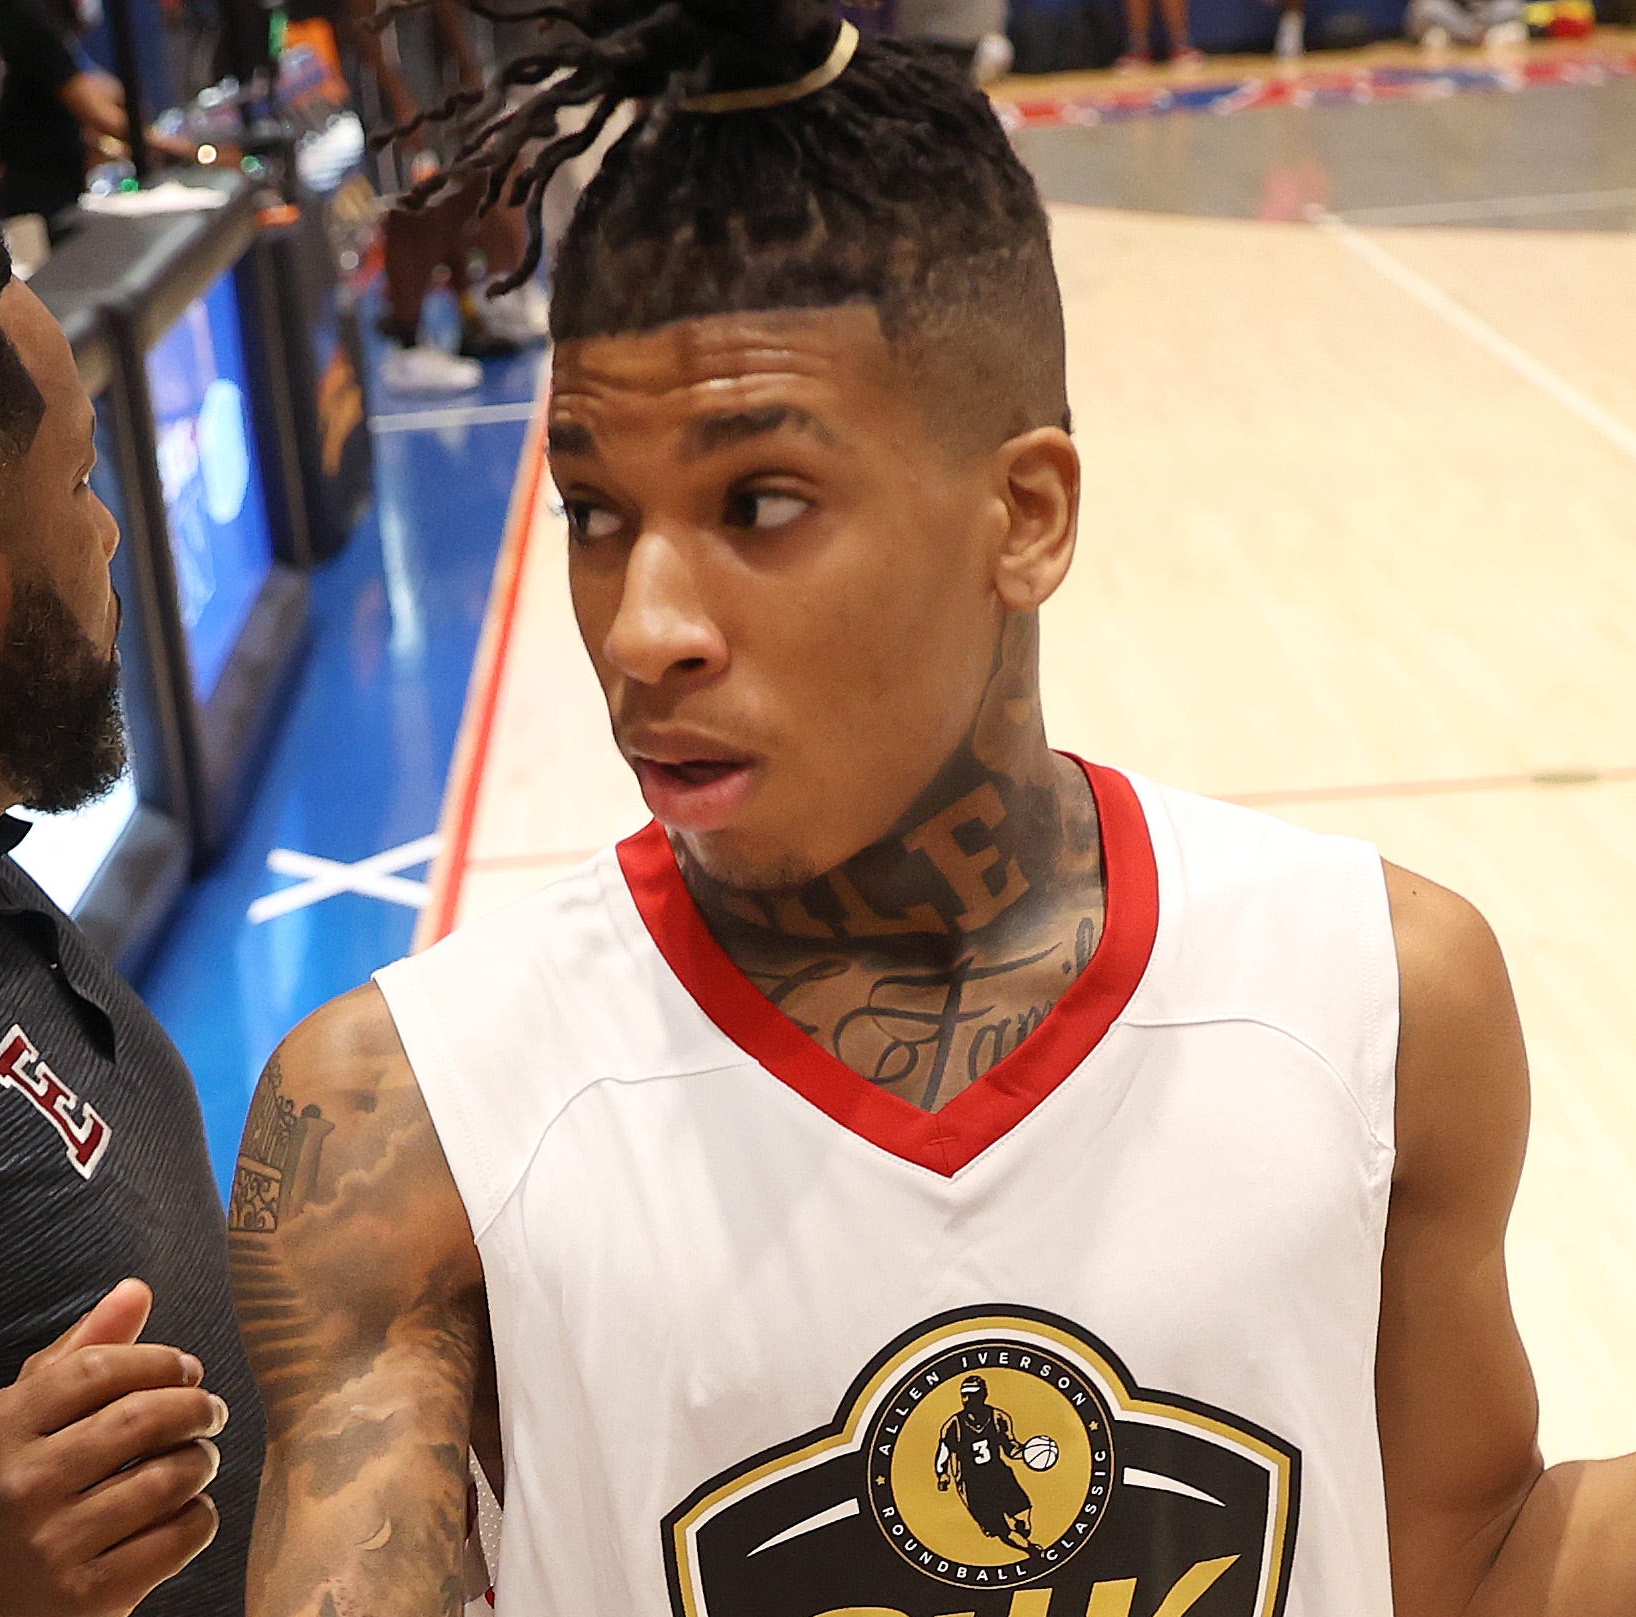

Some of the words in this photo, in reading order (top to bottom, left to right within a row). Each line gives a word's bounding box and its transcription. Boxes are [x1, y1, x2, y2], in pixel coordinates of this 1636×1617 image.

[878, 1371, 940, 1456] ALLEN
[961, 1352, 1087, 1406] IVERSON
[972, 1439, 991, 1465] 3
[882, 1506, 1027, 1581] ROUNDBALL
[1045, 1450, 1107, 1561] CLASSIC
